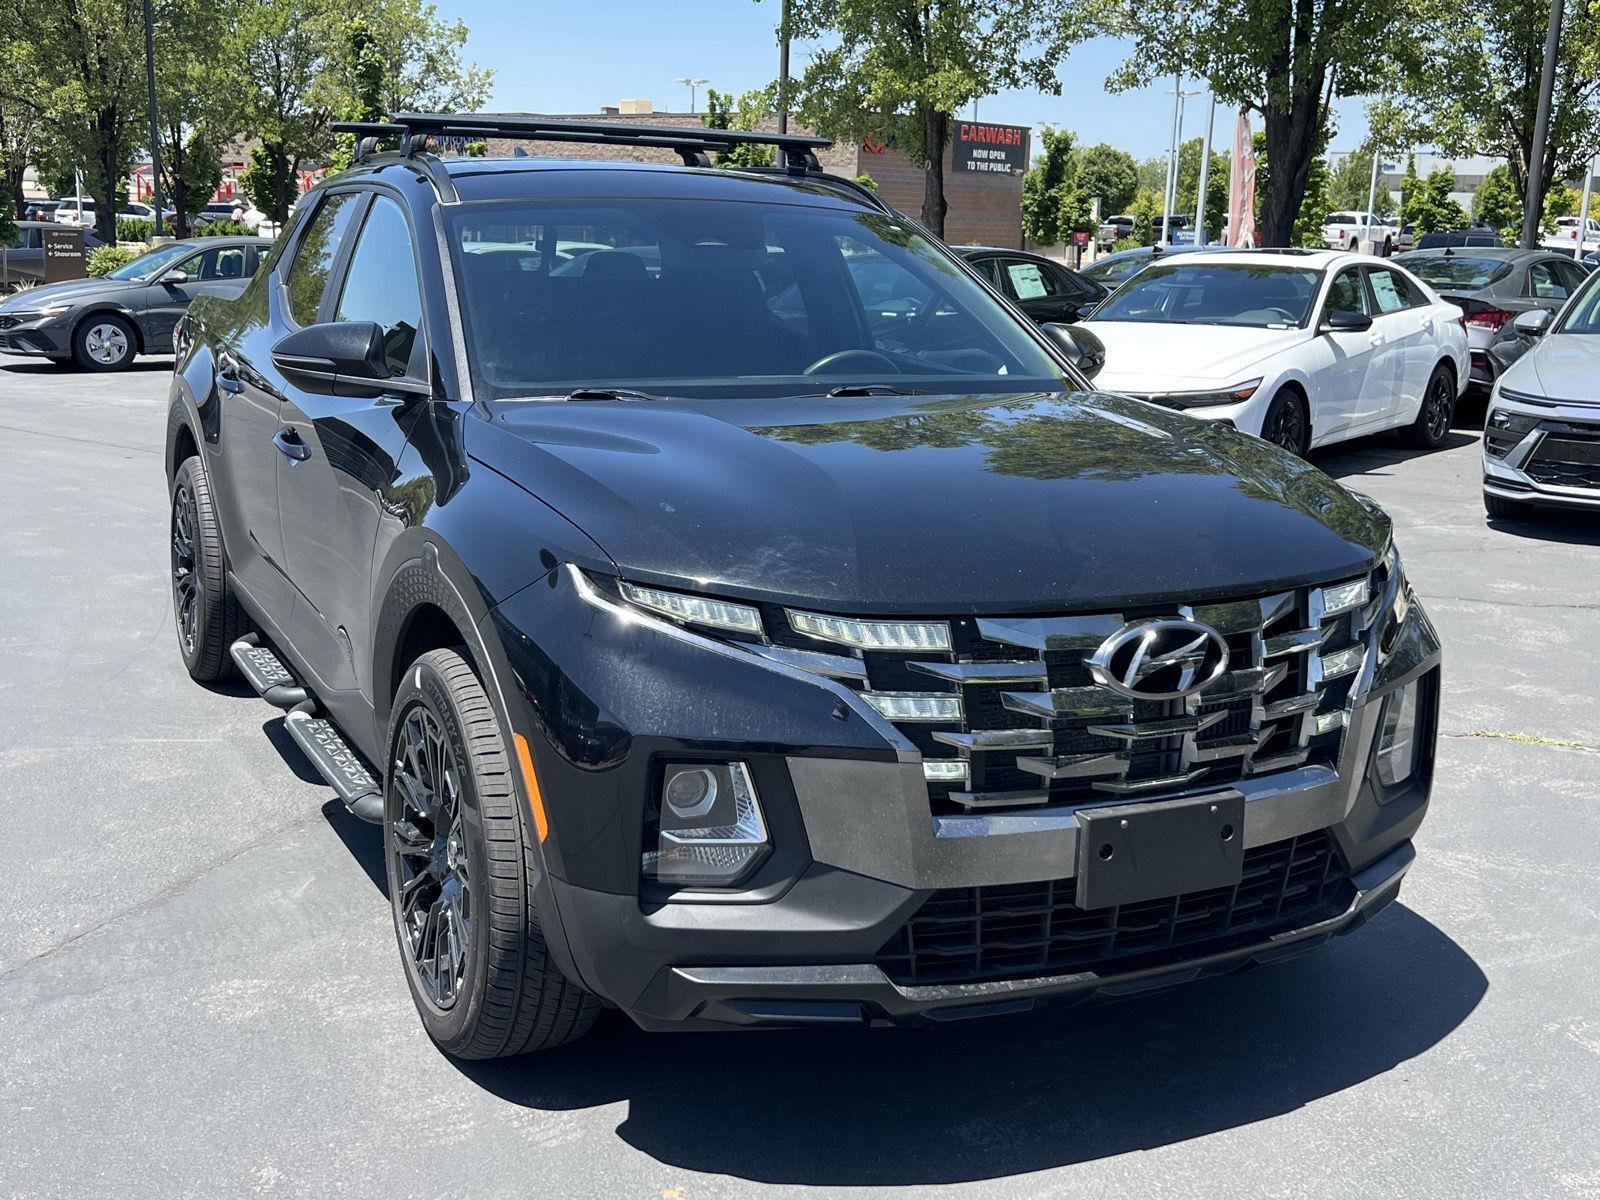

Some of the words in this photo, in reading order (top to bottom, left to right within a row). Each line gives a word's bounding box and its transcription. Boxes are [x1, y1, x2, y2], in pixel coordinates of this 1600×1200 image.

[960, 124, 1021, 145] CARWASH
[973, 149, 988, 158] NOW
[989, 150, 1006, 160] OPEN
[967, 161, 976, 170] TO
[976, 162, 988, 171] THE
[989, 163, 1011, 173] PUBLIC
